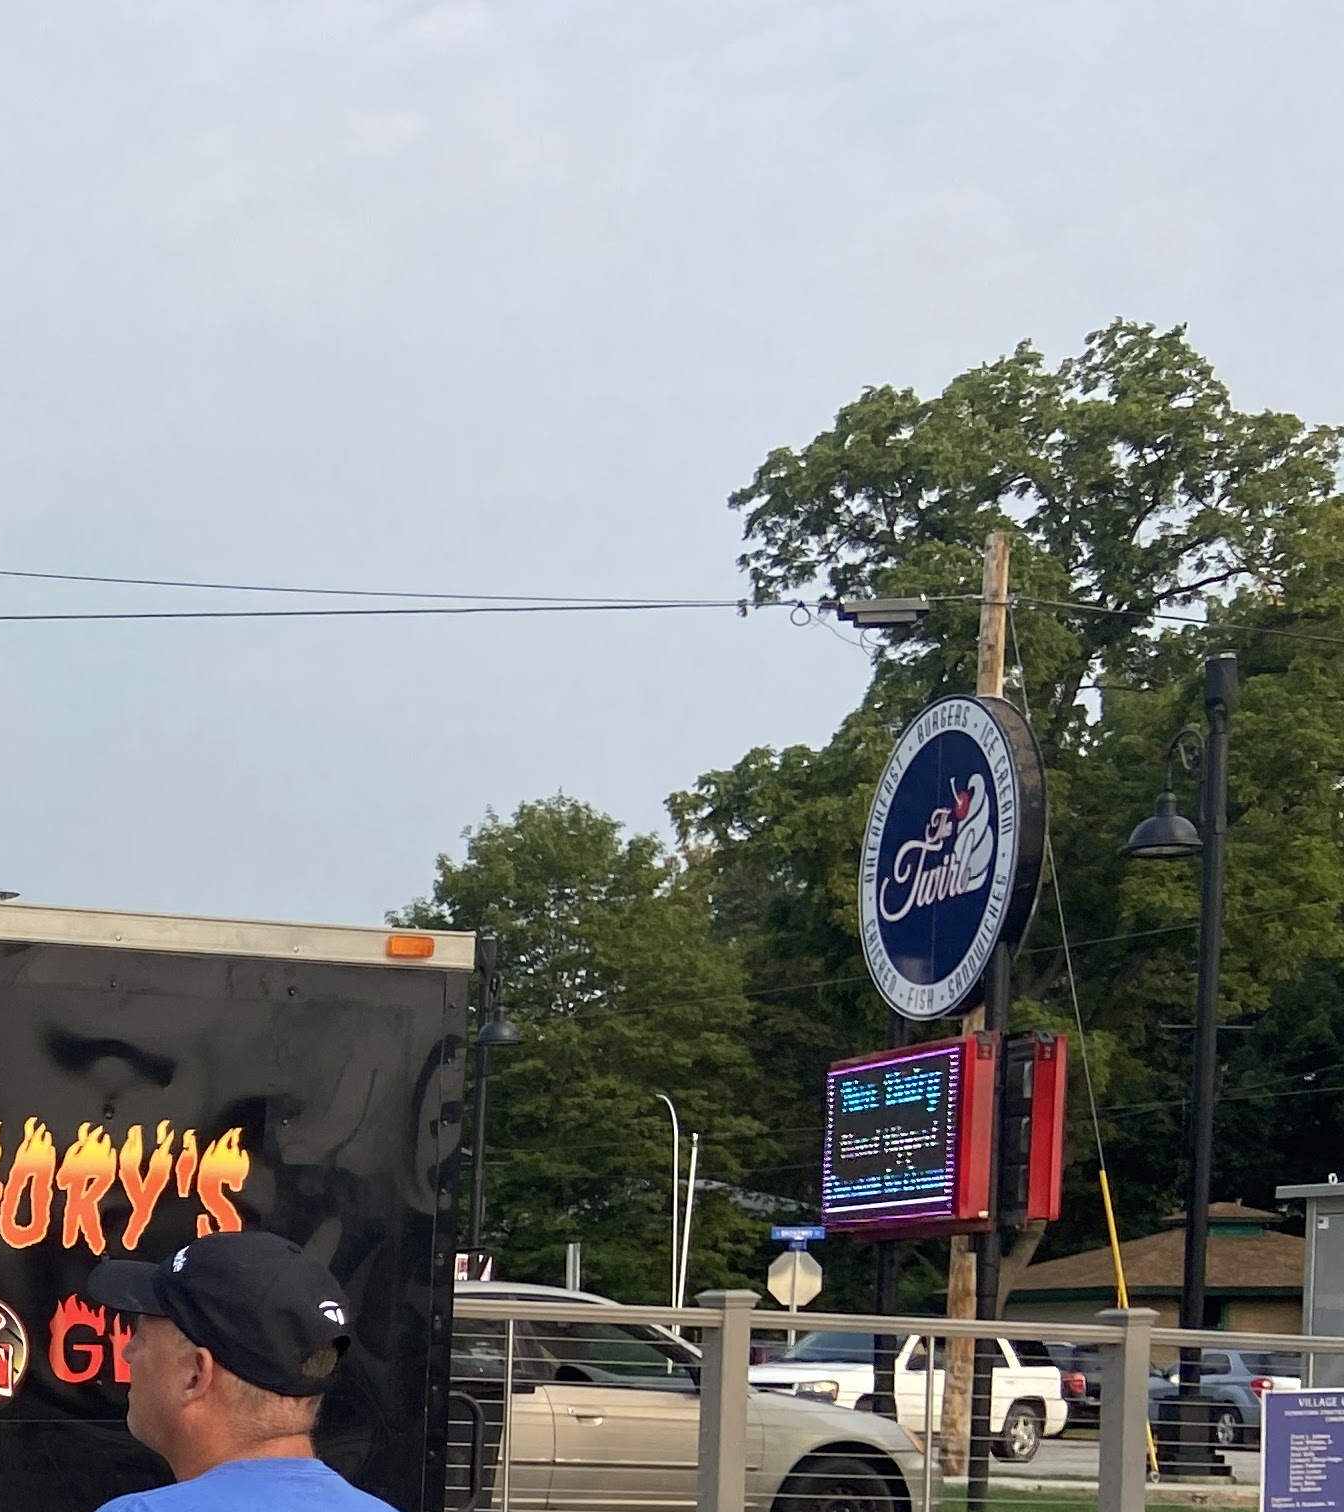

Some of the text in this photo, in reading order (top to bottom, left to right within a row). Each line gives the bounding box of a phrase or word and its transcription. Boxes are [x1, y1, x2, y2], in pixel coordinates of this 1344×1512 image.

[916, 704, 971, 745] BURGERS
[979, 721, 1013, 836] ICE CREAM
[864, 754, 905, 884] BREAKFAST
[925, 807, 954, 845] The
[879, 828, 973, 922] Twirl
[865, 918, 898, 996] CHICKEN
[947, 874, 1008, 1000] SANDWICHES
[906, 987, 934, 1011] FISH
[1298, 1397, 1337, 1408] VILLAGE
